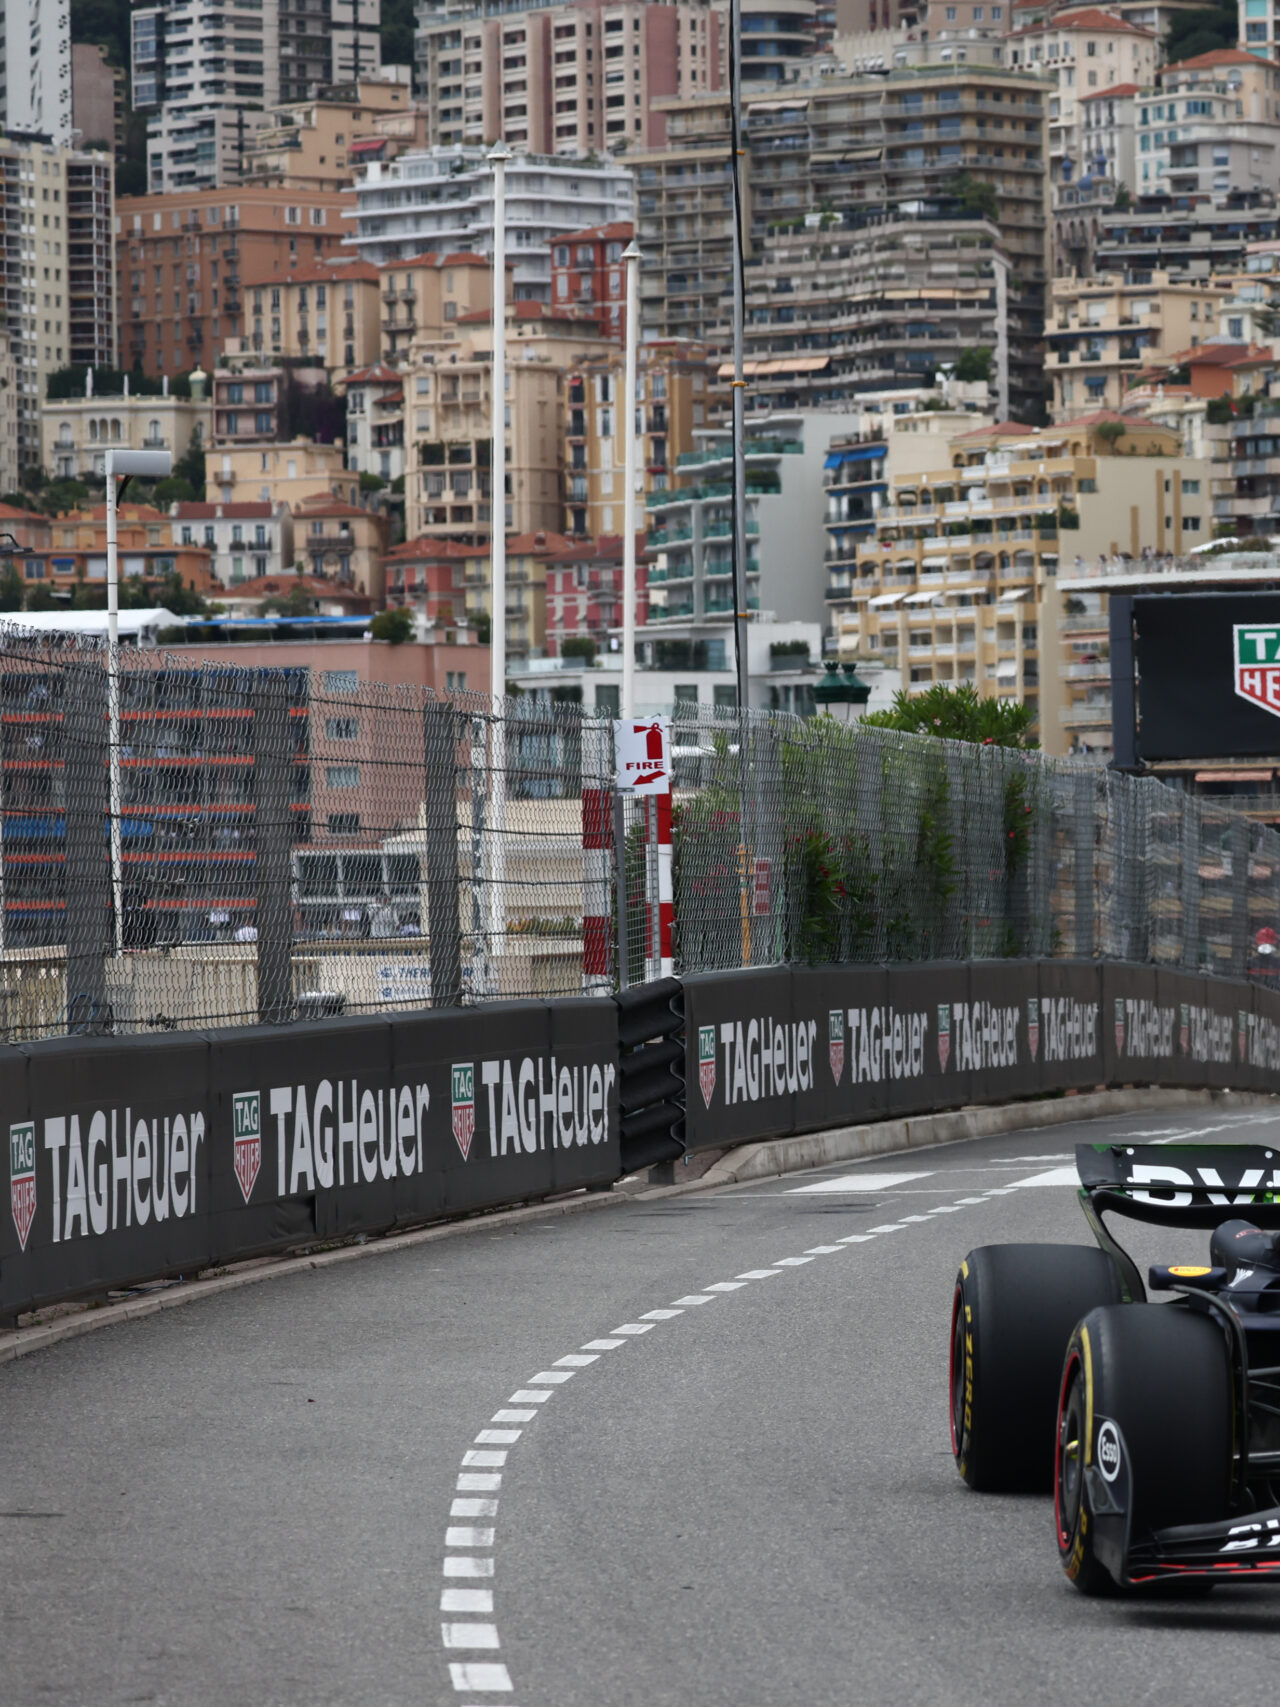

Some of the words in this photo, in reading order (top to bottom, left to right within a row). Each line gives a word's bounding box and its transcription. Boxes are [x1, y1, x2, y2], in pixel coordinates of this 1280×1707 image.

[625, 761, 664, 770] FIRE
[700, 1032, 715, 1057] TAG
[453, 1070, 473, 1099] TAG
[235, 1099, 258, 1133] TAG
[11, 1131, 33, 1170] TAG
[235, 1140, 261, 1192] HEUER
[12, 1180, 36, 1238] HEUER
[964, 1305, 973, 1324] P
[965, 1332, 973, 1431] ZERO
[1101, 1436, 1118, 1464] Esso
